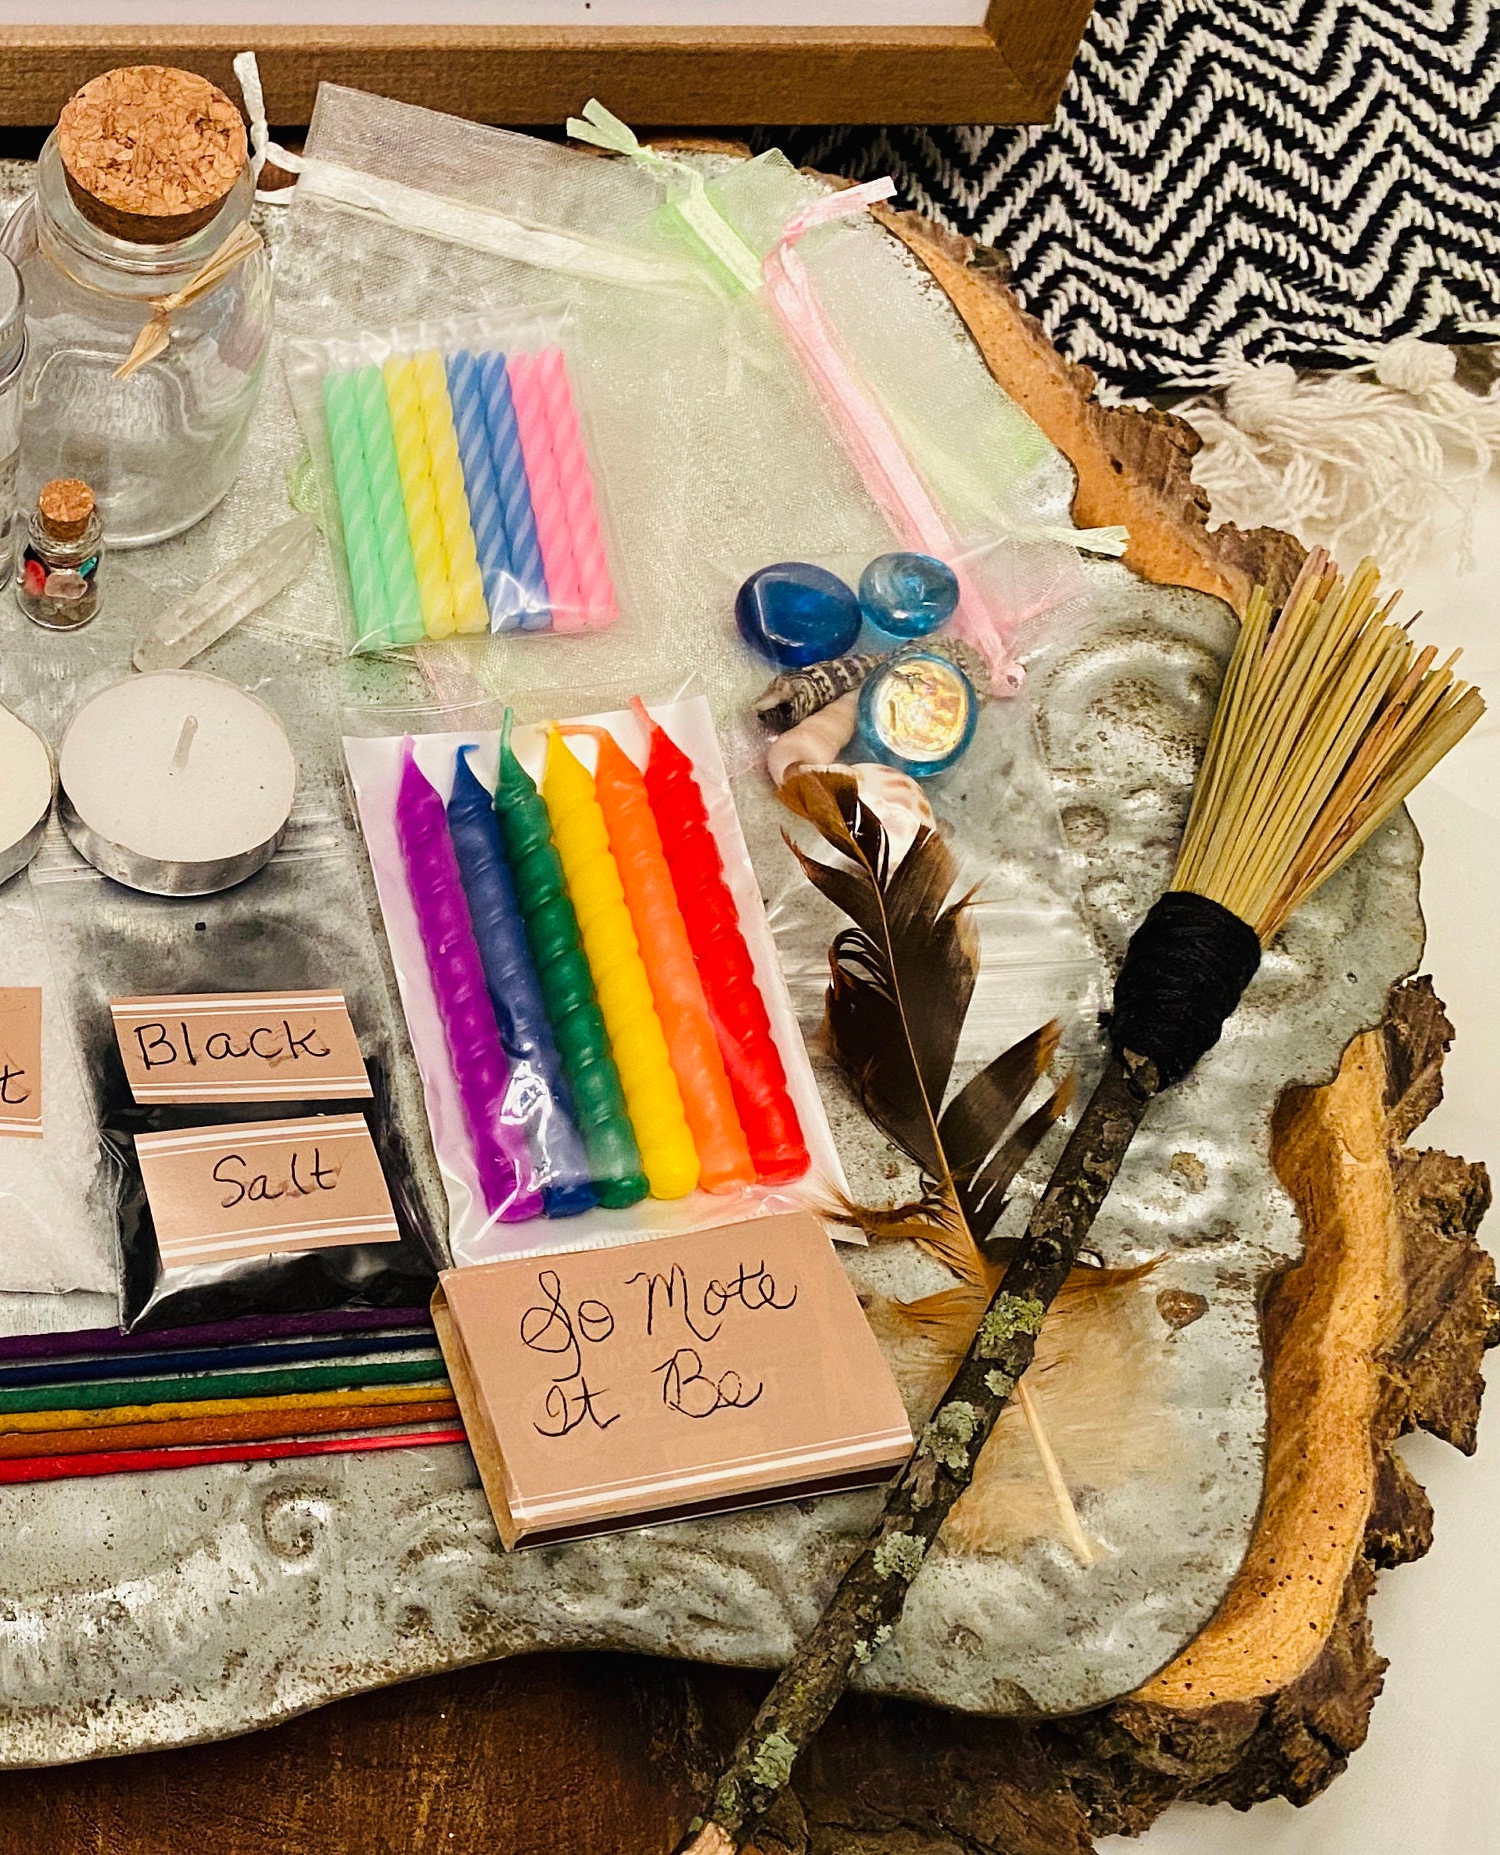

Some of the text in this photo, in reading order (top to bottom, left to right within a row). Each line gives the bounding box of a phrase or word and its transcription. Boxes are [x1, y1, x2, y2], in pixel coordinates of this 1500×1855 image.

[134, 1020, 331, 1070] Black
[212, 1148, 337, 1208] Salt
[521, 1270, 614, 1381] So
[625, 1260, 797, 1341] Mote
[533, 1376, 620, 1436] It
[652, 1348, 763, 1418] Be
